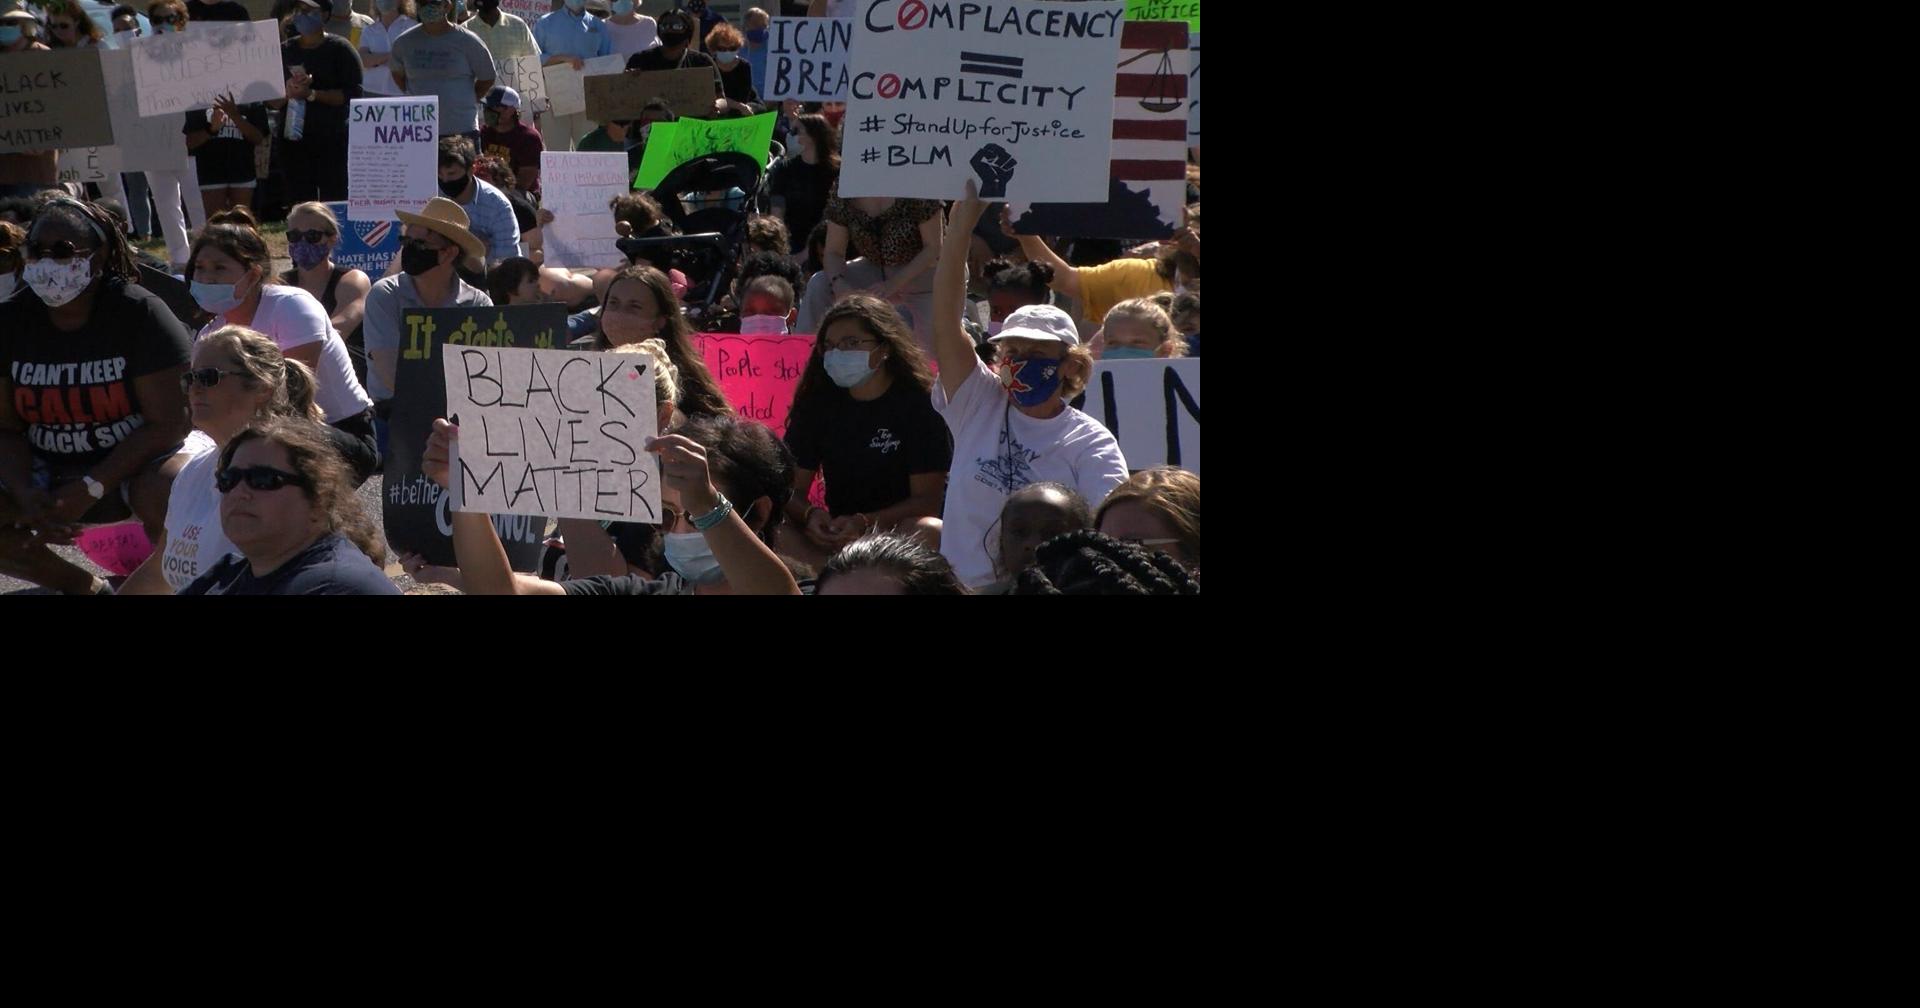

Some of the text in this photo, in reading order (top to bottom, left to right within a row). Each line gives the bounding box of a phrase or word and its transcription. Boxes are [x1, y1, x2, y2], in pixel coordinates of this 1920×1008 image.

[1130, 3, 1199, 20] JUSTICE
[0, 69, 67, 93] LACK
[852, 72, 1085, 110] COMPLICITY
[353, 103, 437, 122] SAY THEIR
[374, 125, 433, 143] NAMES
[338, 253, 364, 264] HATE
[367, 252, 389, 262] HAS
[402, 314, 436, 360] It
[19, 361, 78, 386] CAN'T
[80, 356, 127, 385] KEEP
[461, 349, 636, 418] BLACK
[14, 381, 132, 425] CALM
[482, 415, 637, 465] LIVES
[458, 457, 655, 519] MATTER
[182, 525, 203, 541] USE
[171, 538, 199, 559] YOUR
[163, 555, 198, 576] VOICE
